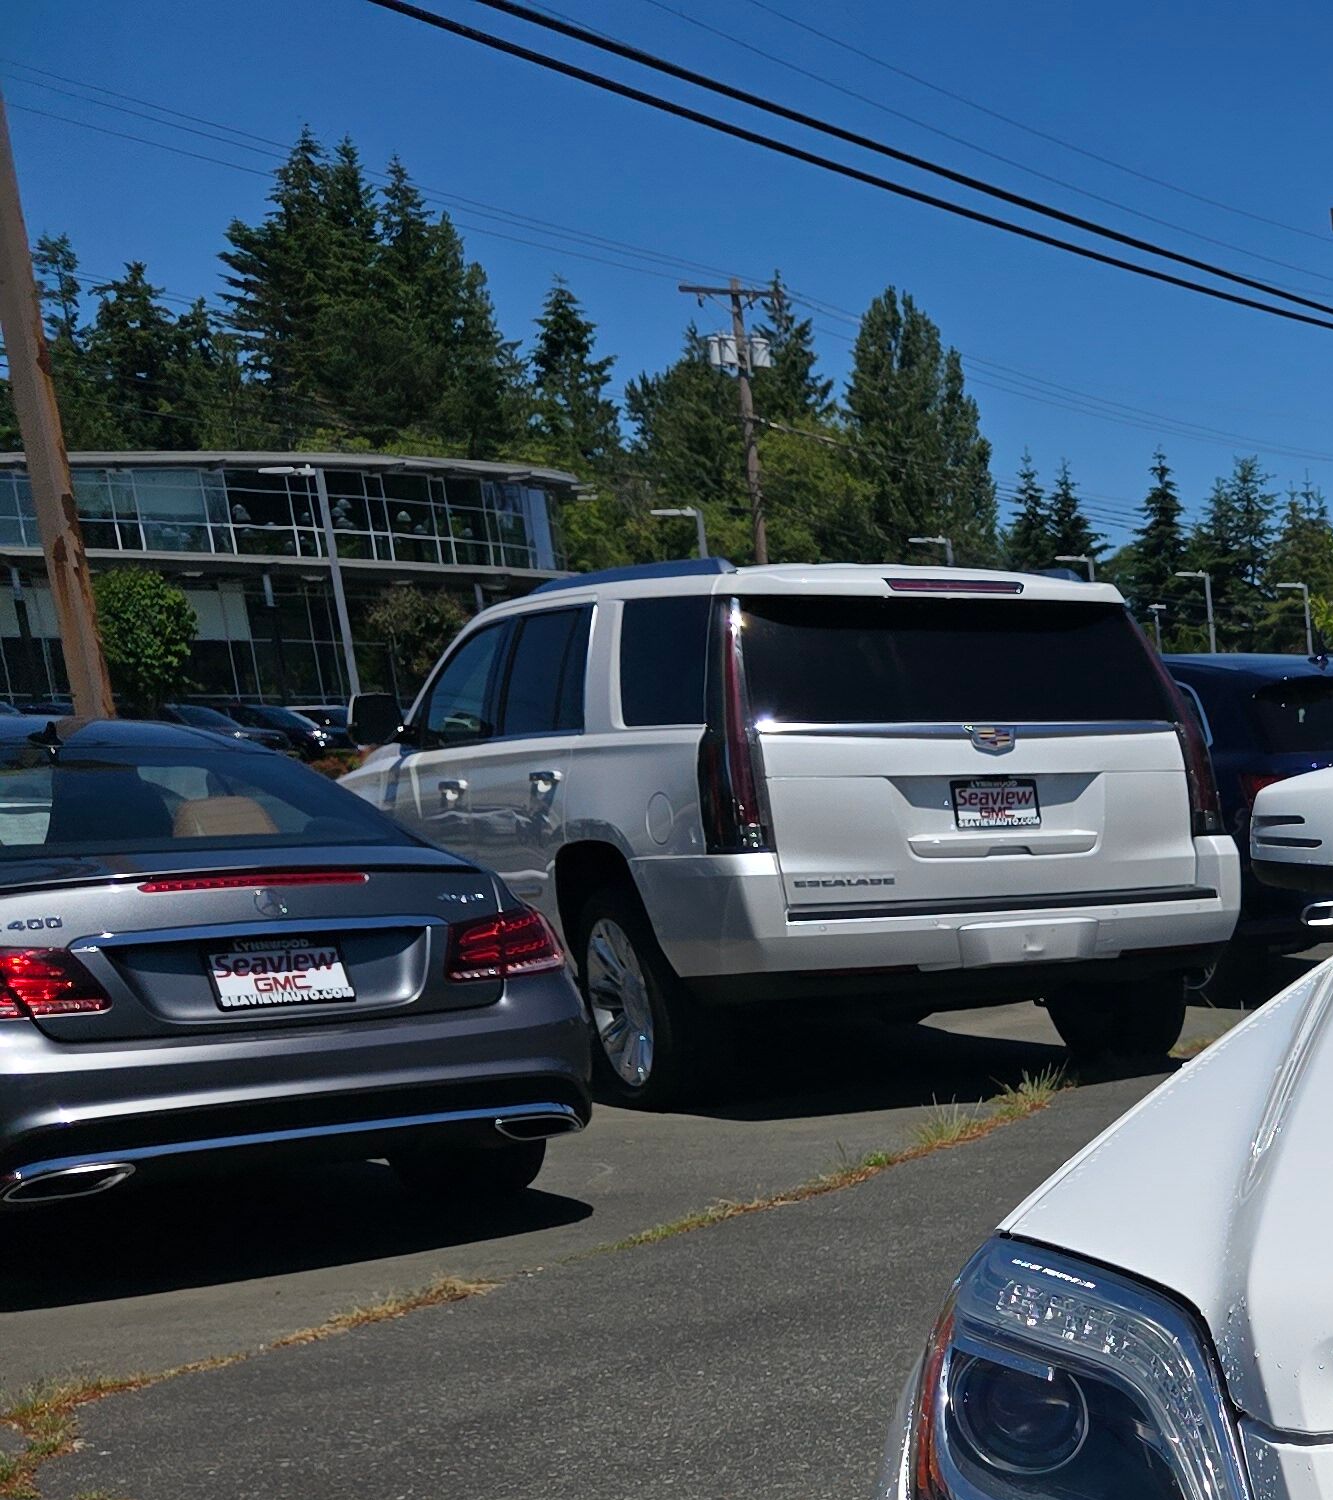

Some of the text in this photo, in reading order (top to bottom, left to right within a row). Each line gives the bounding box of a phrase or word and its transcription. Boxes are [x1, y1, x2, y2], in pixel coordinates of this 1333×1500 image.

[957, 788, 1034, 806] Seaview
[980, 807, 1015, 819] GMC
[794, 878, 895, 888] ESCALADE
[8, 917, 63, 931] 400
[232, 939, 310, 952] LYNNWOOD
[215, 950, 338, 978] Seaview
[254, 975, 312, 992] GMC
[221, 986, 355, 1007] SEAVIEWAUTO.COM
